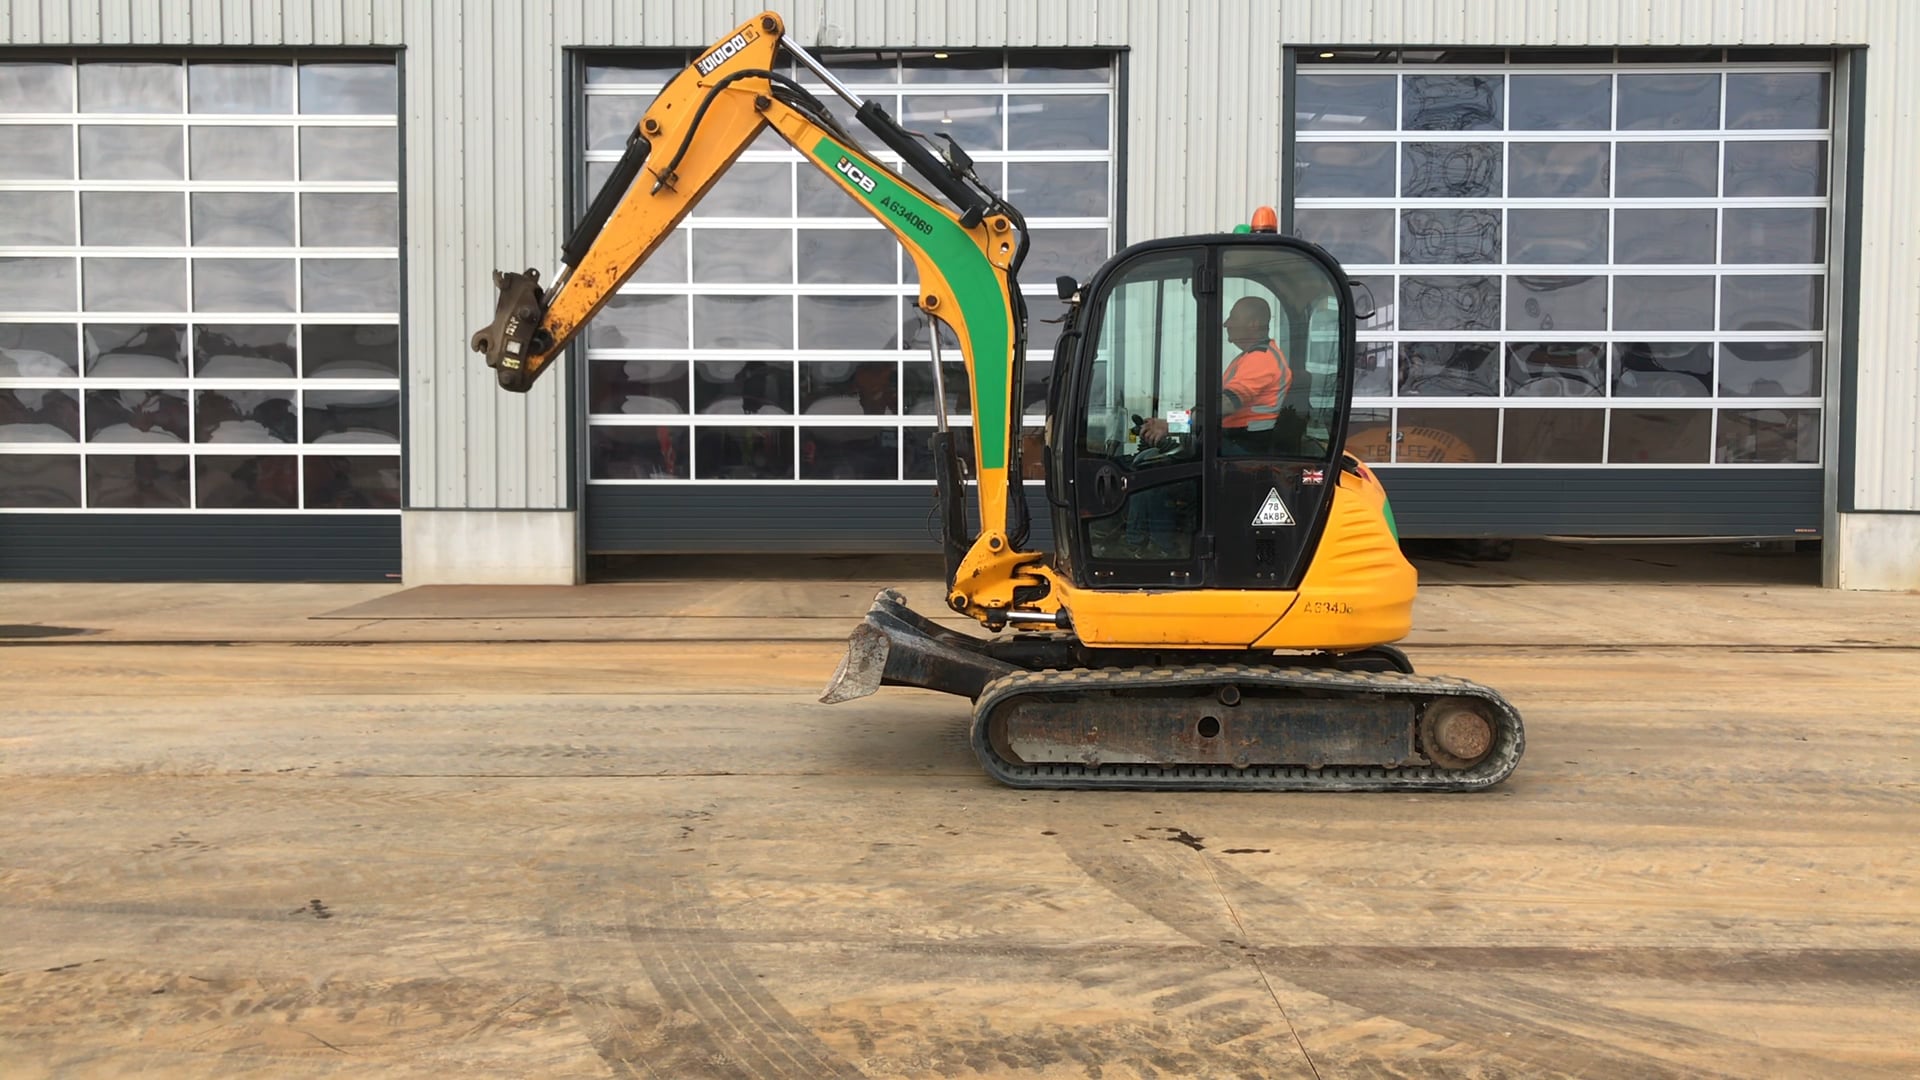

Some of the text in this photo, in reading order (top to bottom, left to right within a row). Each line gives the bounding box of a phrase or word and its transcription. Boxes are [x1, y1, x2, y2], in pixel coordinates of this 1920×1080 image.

[836, 157, 877, 193] JCB
[880, 196, 933, 235] A634069
[1268, 502, 1279, 511] 78
